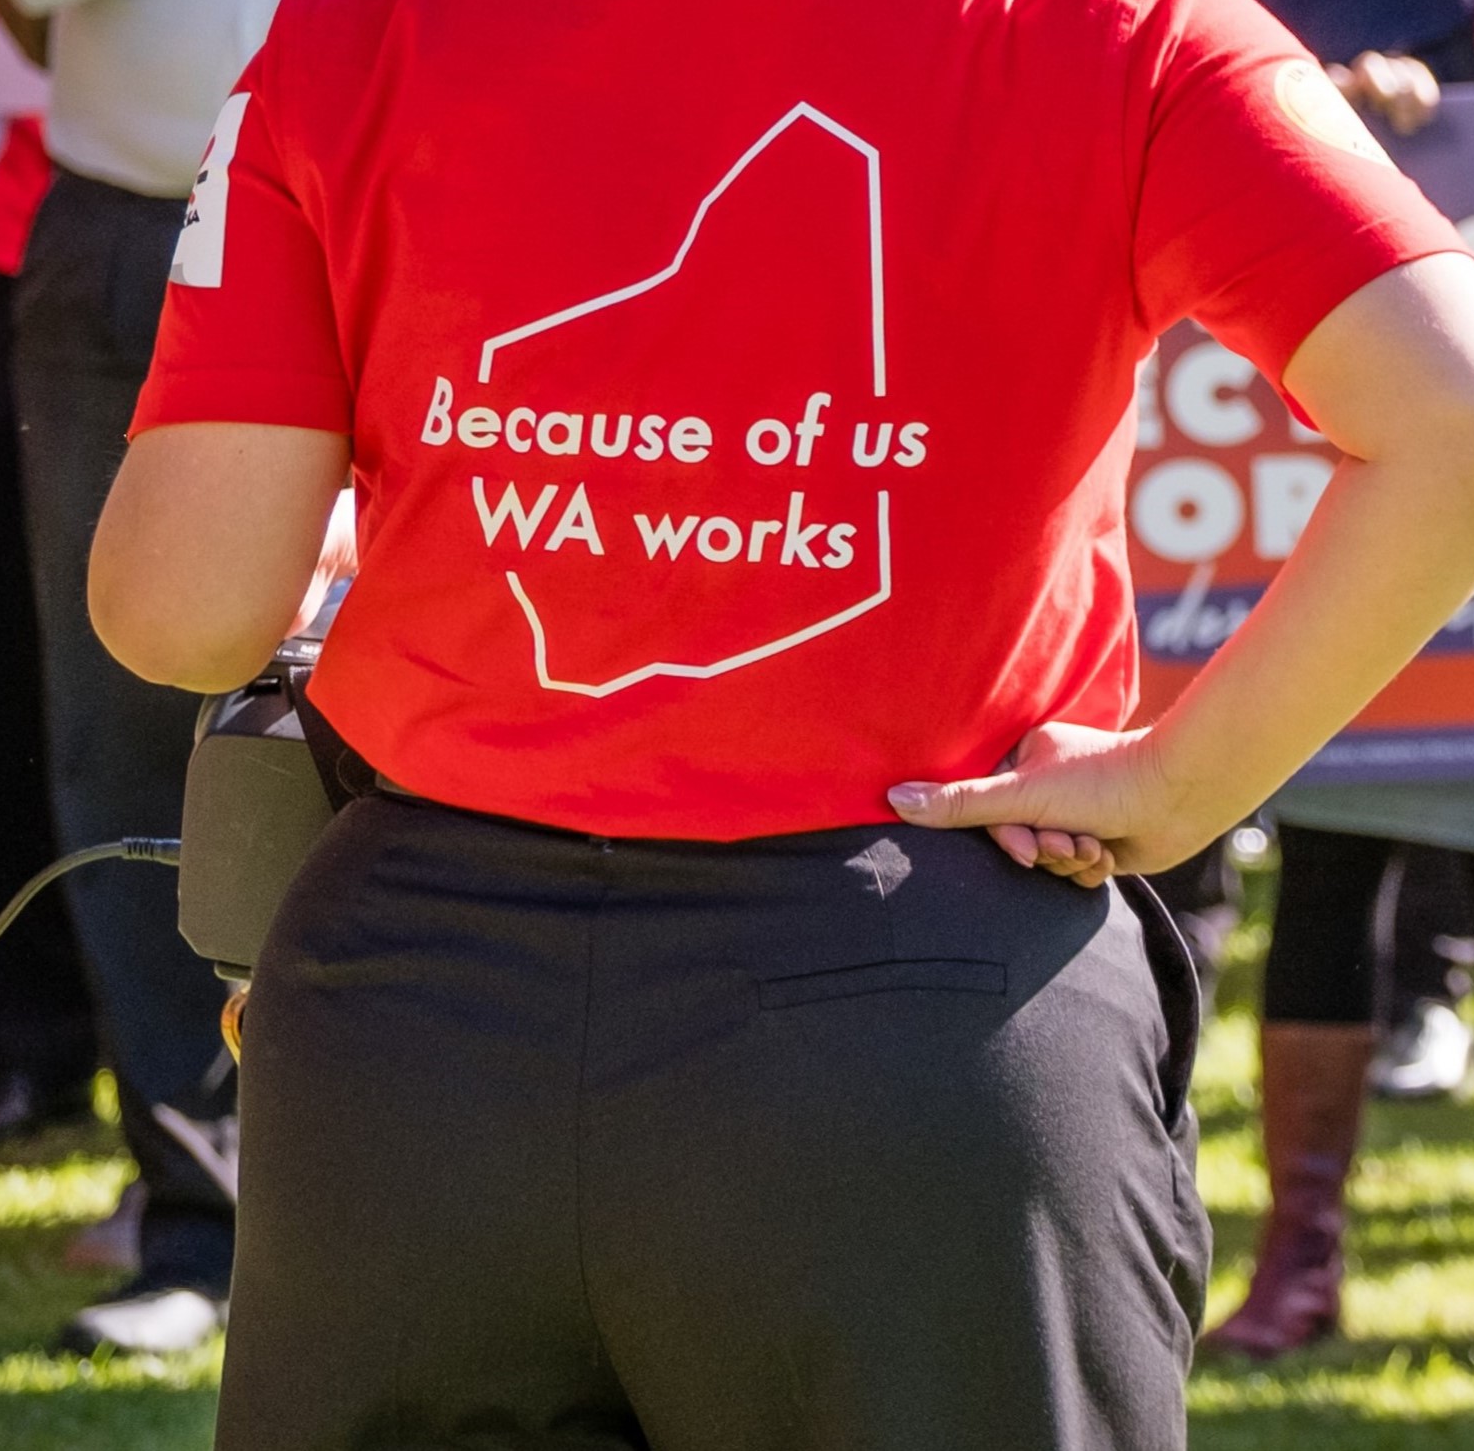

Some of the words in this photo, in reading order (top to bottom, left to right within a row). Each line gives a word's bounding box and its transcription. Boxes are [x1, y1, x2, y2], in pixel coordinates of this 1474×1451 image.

[420, 376, 713, 463] Because
[746, 392, 832, 466] of
[852, 421, 929, 468] us
[472, 476, 605, 556] WA
[633, 491, 858, 569] works
